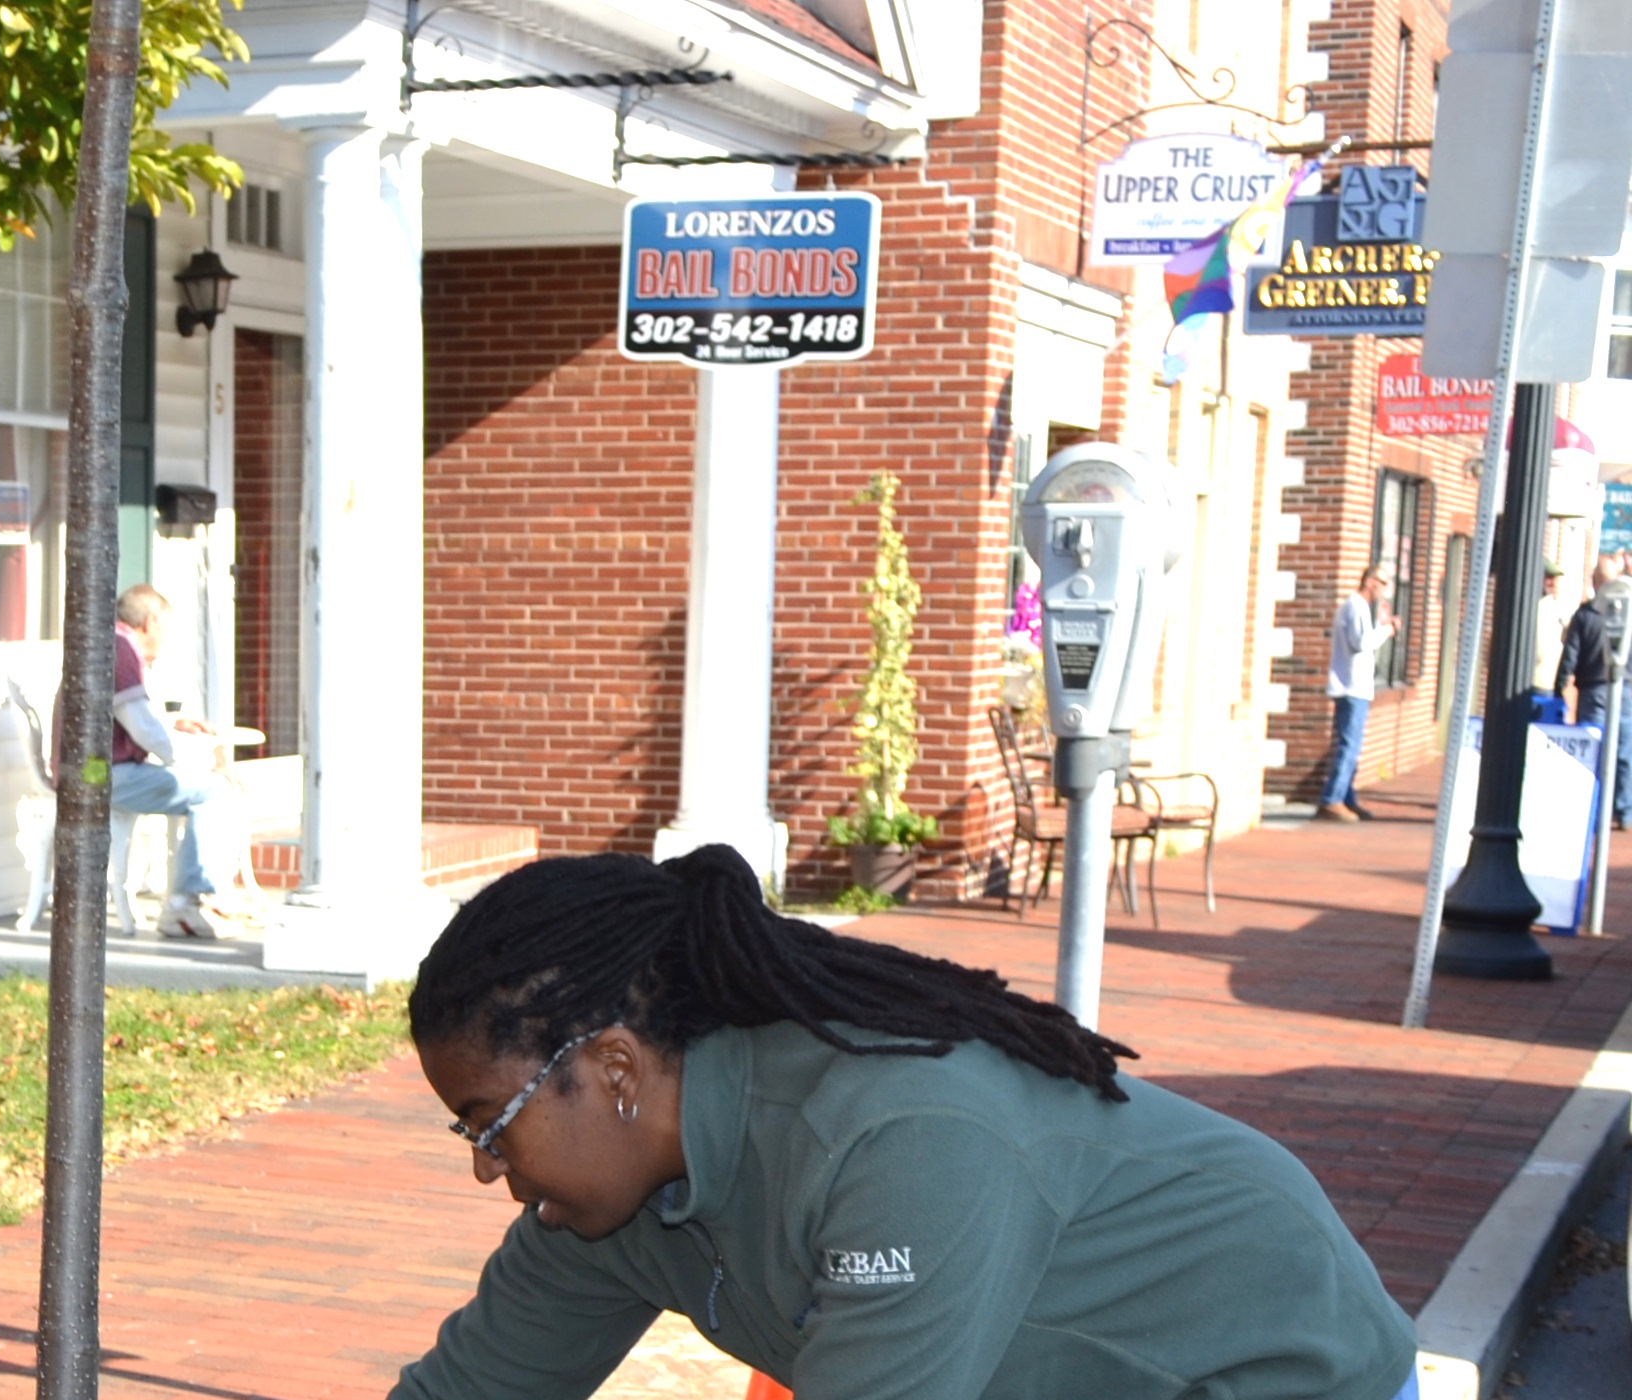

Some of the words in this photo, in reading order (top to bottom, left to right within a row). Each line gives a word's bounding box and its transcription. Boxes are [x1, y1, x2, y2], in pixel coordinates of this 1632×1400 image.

[1168, 147, 1213, 168] THE
[1103, 174, 1179, 203] UPPER
[1191, 173, 1276, 202] CRUST
[665, 208, 836, 238] LORENZOS
[1283, 239, 1424, 274] ARCHER
[635, 247, 718, 299] BAIL
[730, 246, 860, 298] BONDS
[631, 313, 859, 343] 302-542-1418
[1381, 374, 1426, 398] BAIL
